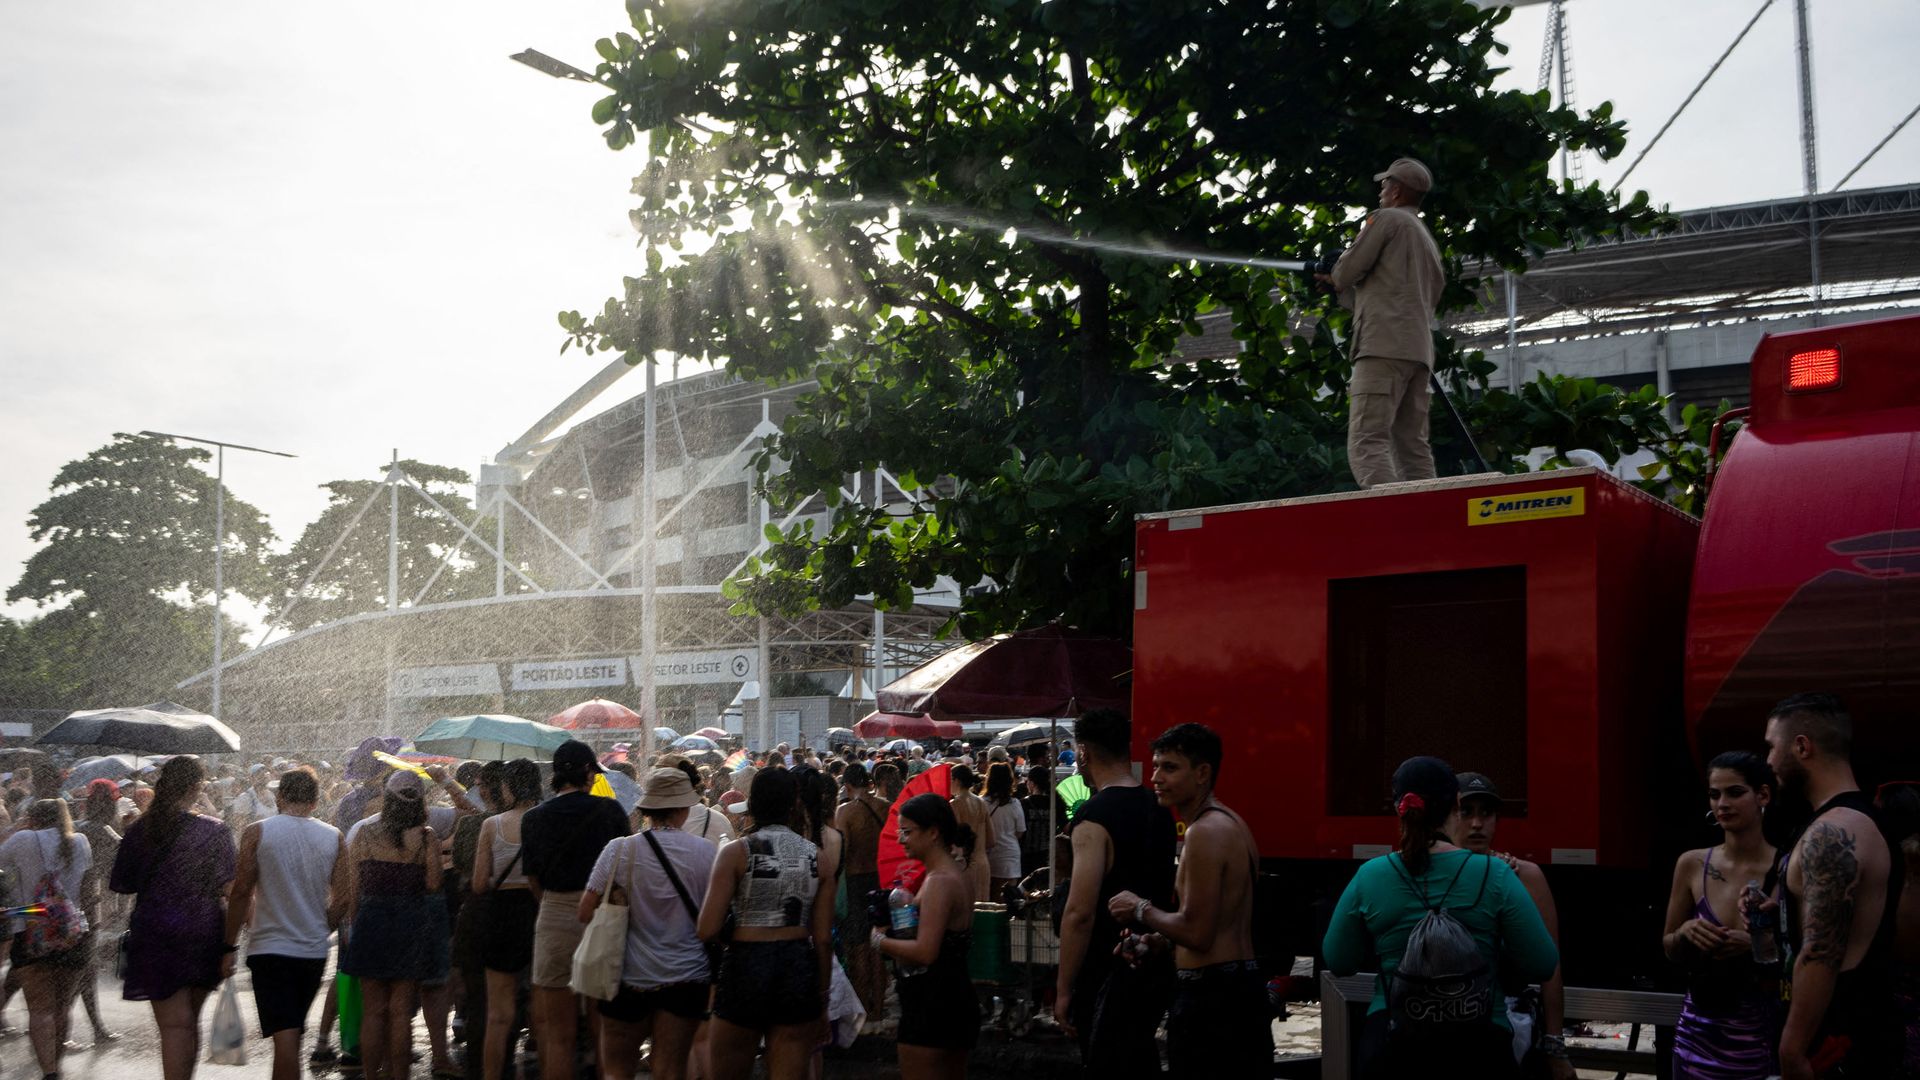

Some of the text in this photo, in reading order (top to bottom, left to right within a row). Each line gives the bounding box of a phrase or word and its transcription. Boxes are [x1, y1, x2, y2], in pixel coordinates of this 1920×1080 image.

[1495, 496, 1573, 512] MITREN
[521, 664, 617, 682] PORTÃO LESTE
[654, 662, 722, 676] SETOR LESTE
